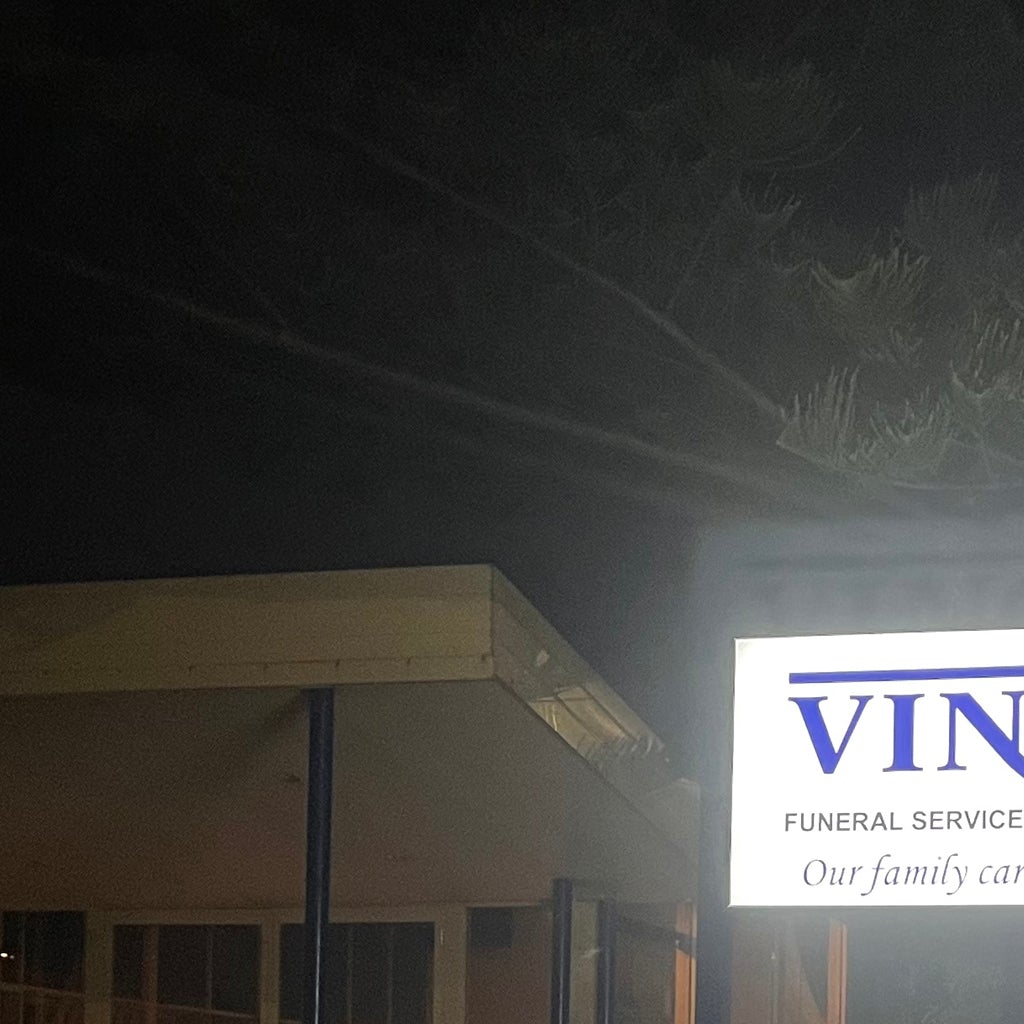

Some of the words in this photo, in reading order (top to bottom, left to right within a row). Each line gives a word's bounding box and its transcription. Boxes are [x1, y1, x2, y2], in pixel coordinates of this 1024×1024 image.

[784, 811, 903, 832] FUNERAL
[803, 859, 864, 886] Our
[860, 853, 967, 897] family
